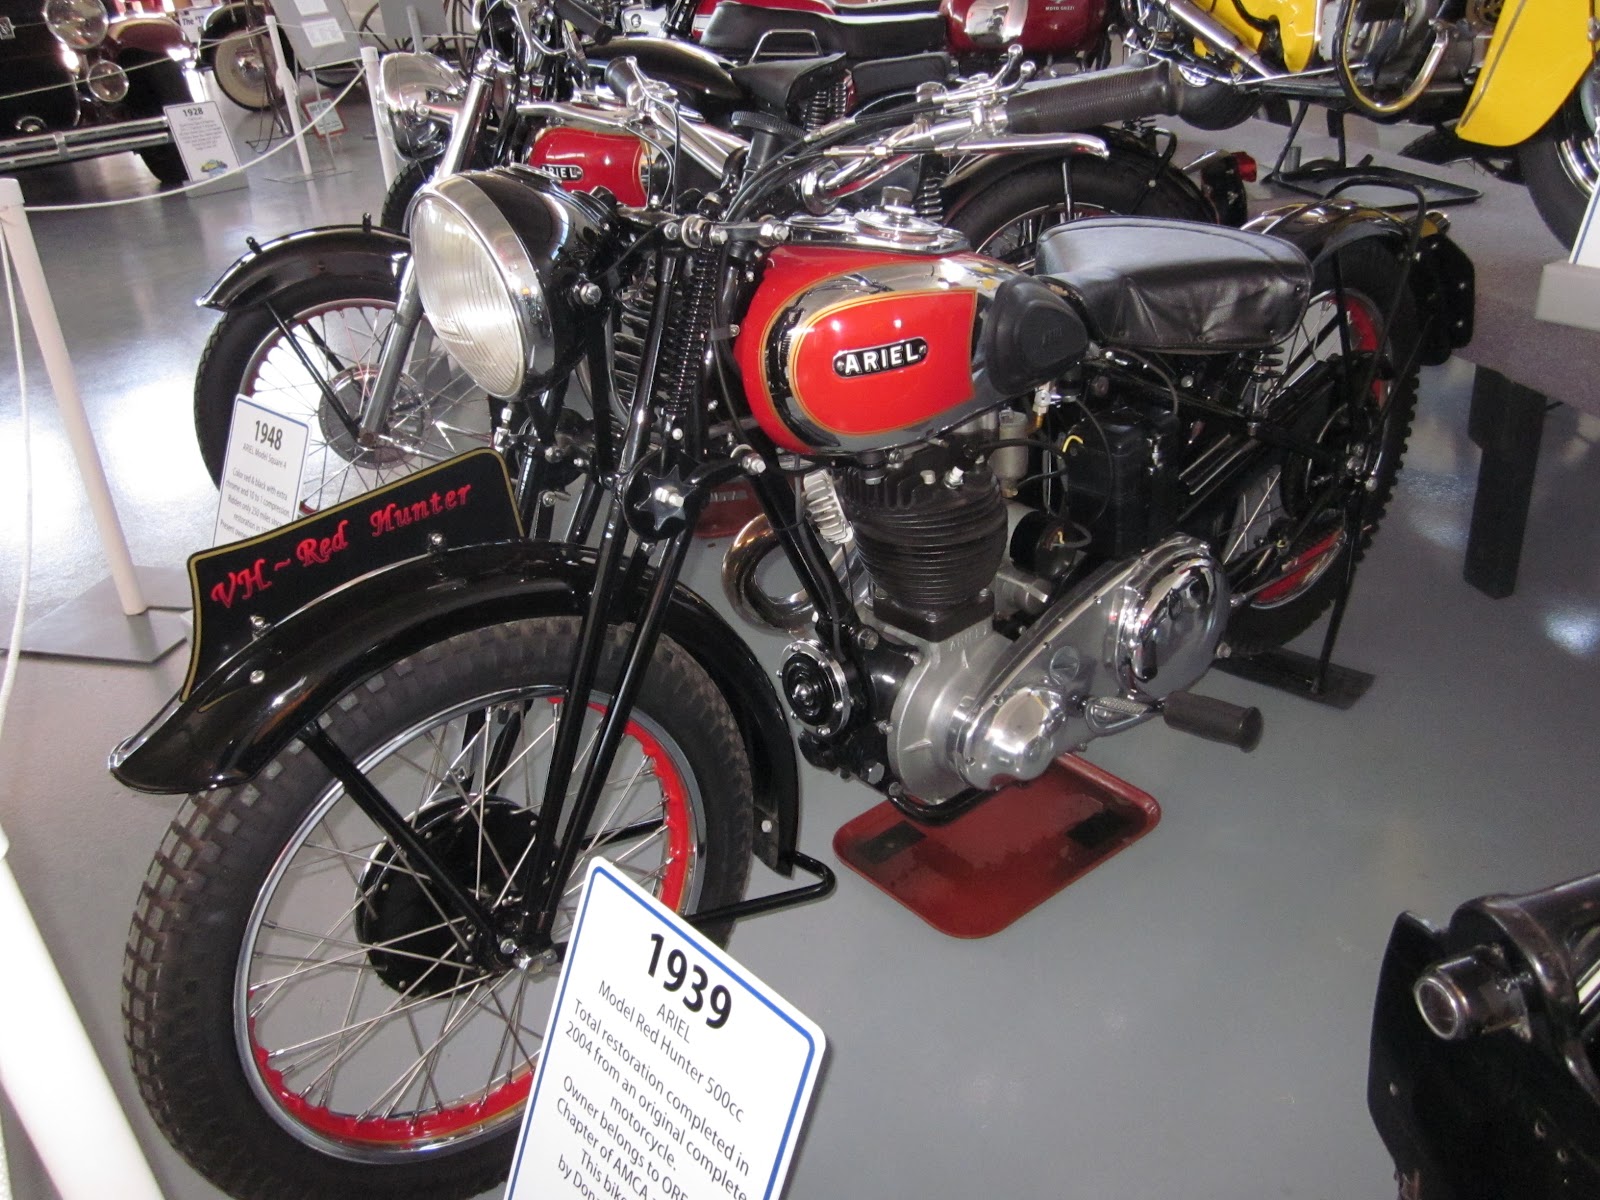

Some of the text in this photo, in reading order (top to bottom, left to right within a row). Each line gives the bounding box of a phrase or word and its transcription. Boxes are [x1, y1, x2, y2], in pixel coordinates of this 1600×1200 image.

[182, 107, 204, 117] 1928
[845, 343, 920, 375] ARIEL
[254, 420, 283, 450] 1948
[254, 448, 268, 462] Model
[255, 478, 266, 490] black
[370, 484, 472, 538] Hunter
[648, 933, 732, 1029] 1939
[656, 1003, 690, 1044] ARIEL
[598, 980, 745, 1123] Model Red Hunter 500cc
[565, 1022, 592, 1058] 2004
[592, 1046, 620, 1088] from
[622, 1080, 637, 1102] an
[638, 1093, 685, 1144] original
[575, 999, 749, 1176] Total restoration completed in
[556, 1097, 648, 1200] Chapter of AMCA
[563, 1075, 599, 1121] Owner
[600, 1116, 645, 1168] belongs
[647, 1162, 660, 1182] to
[610, 1096, 677, 1171] motorcycle.
[558, 1154, 600, 1200] by Don
[582, 1148, 627, 1200] This bik
